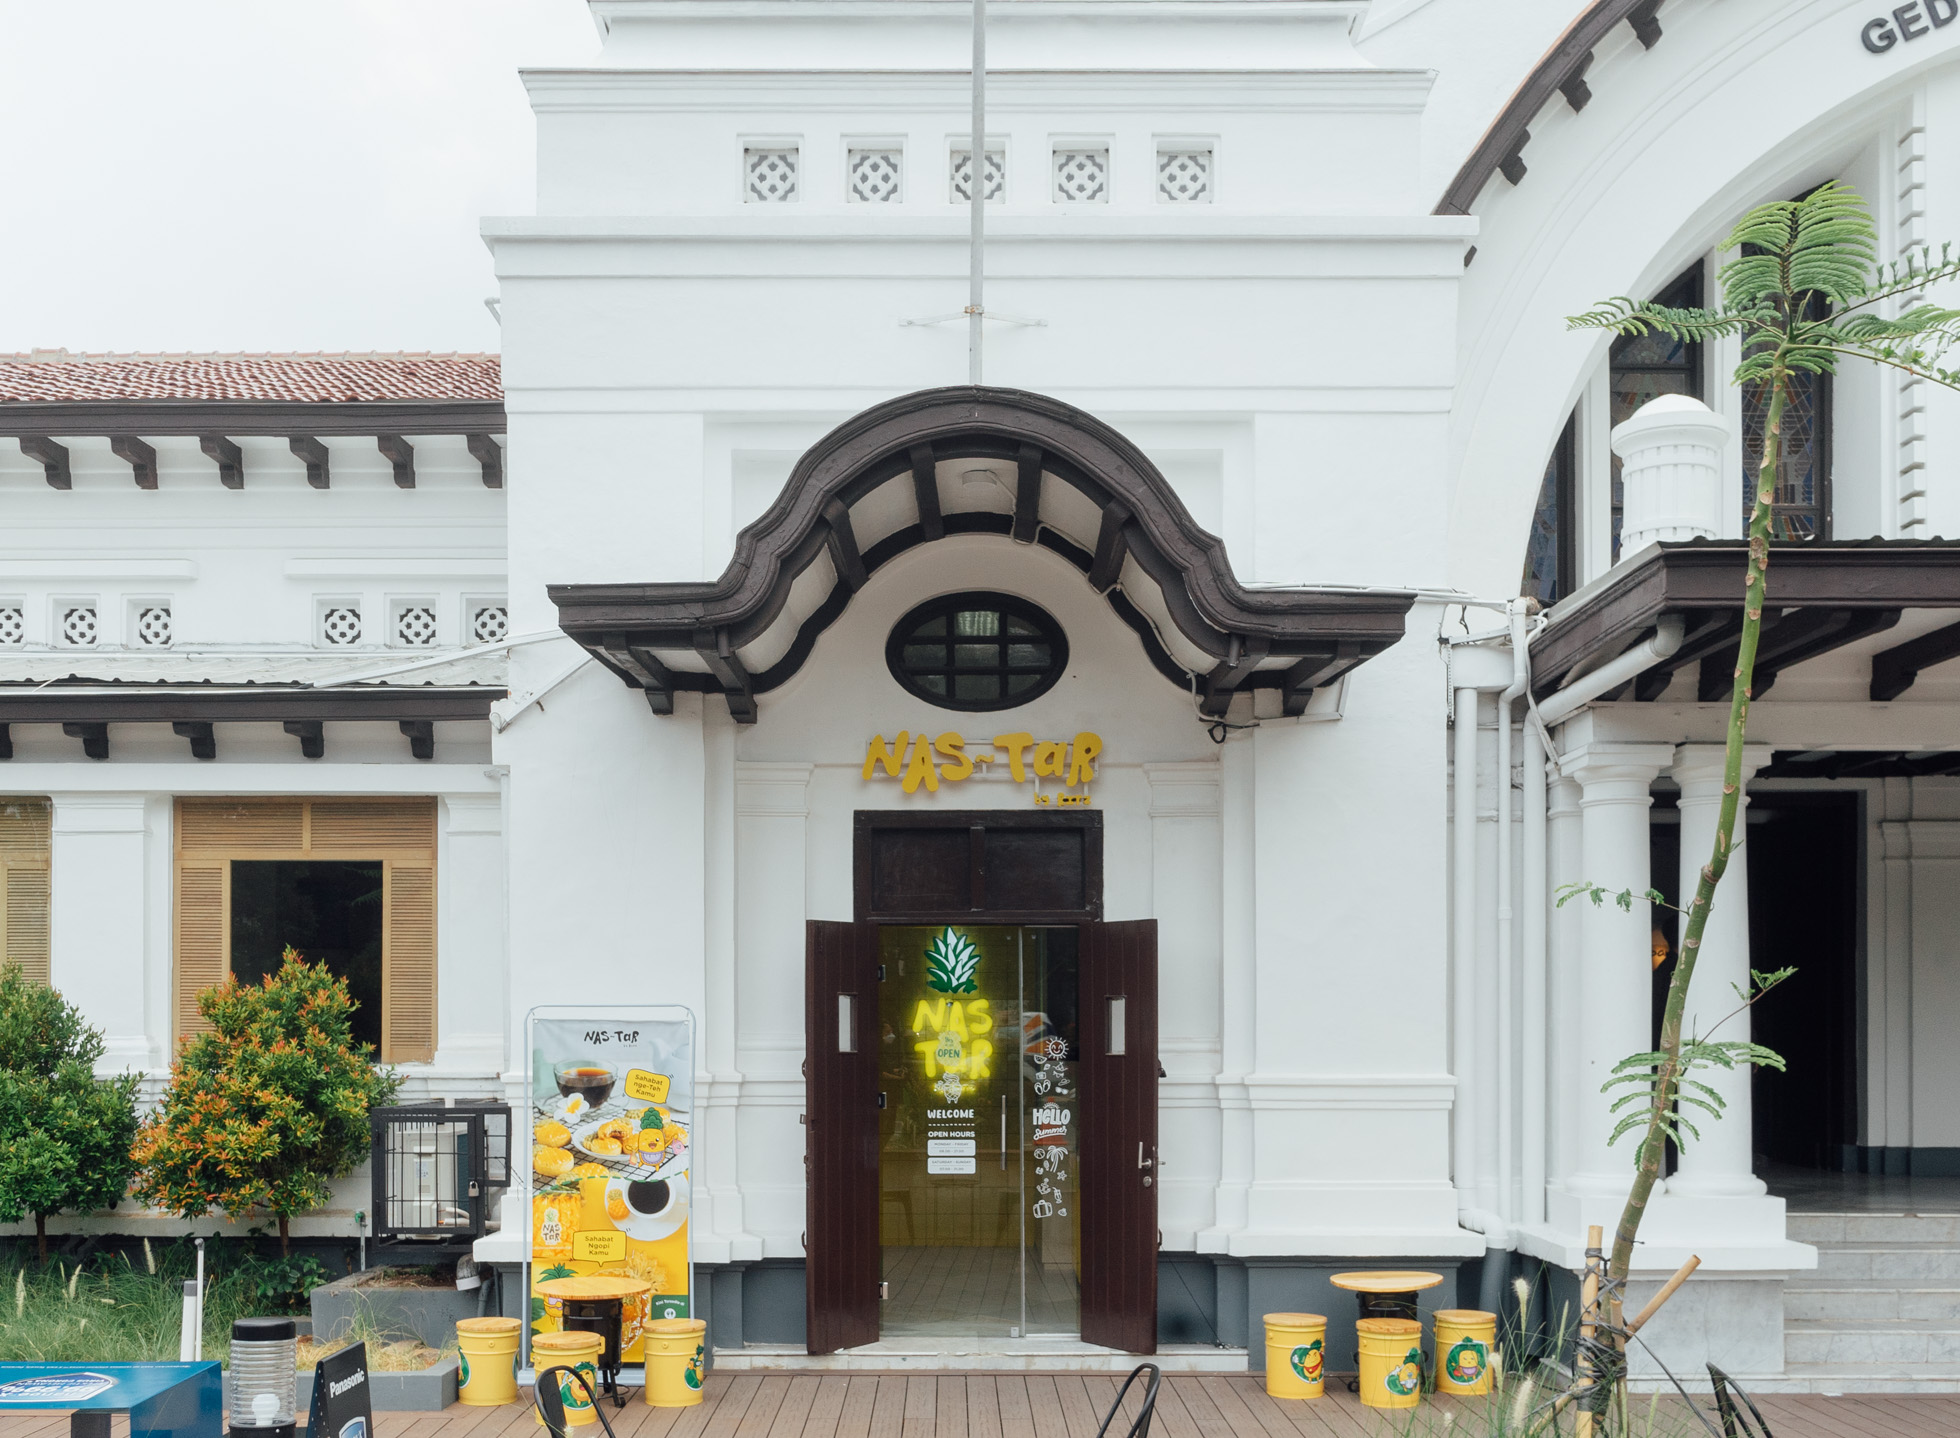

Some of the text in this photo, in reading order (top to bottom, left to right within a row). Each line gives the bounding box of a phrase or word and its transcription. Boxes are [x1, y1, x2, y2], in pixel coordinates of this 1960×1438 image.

[1861, 0, 1958, 54] GED
[912, 998, 993, 1043] NAS
[938, 1048, 960, 1058] OPEN
[635, 1074, 663, 1085] Sahabat
[636, 1089, 656, 1098] Kamu
[927, 1109, 975, 1119] WELCOME
[543, 1224, 560, 1234] NAS
[329, 1368, 365, 1398] Panasonic
